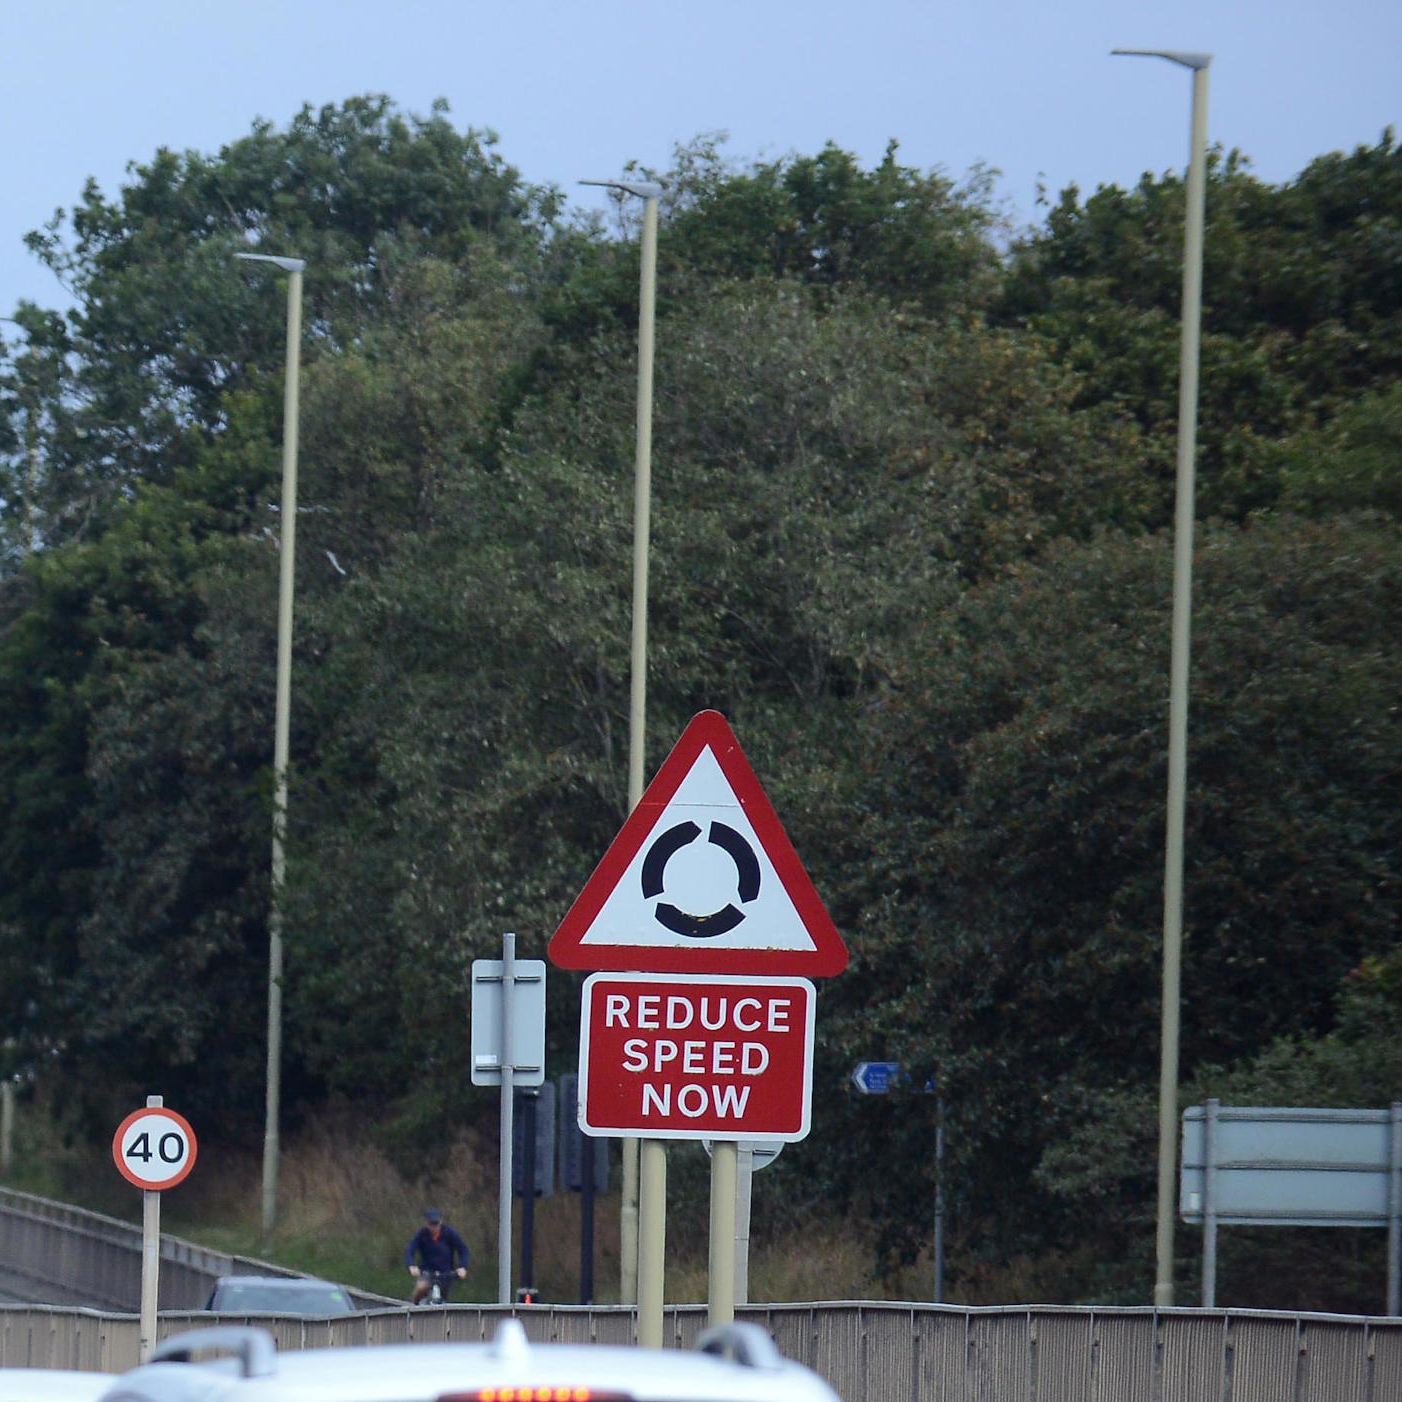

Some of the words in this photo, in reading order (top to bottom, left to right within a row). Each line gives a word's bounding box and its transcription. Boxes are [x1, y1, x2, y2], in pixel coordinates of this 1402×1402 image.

[605, 994, 792, 1033] REDUCE
[621, 1038, 770, 1076] SPEED
[641, 1083, 751, 1119] NOW
[125, 1131, 185, 1164] 40
